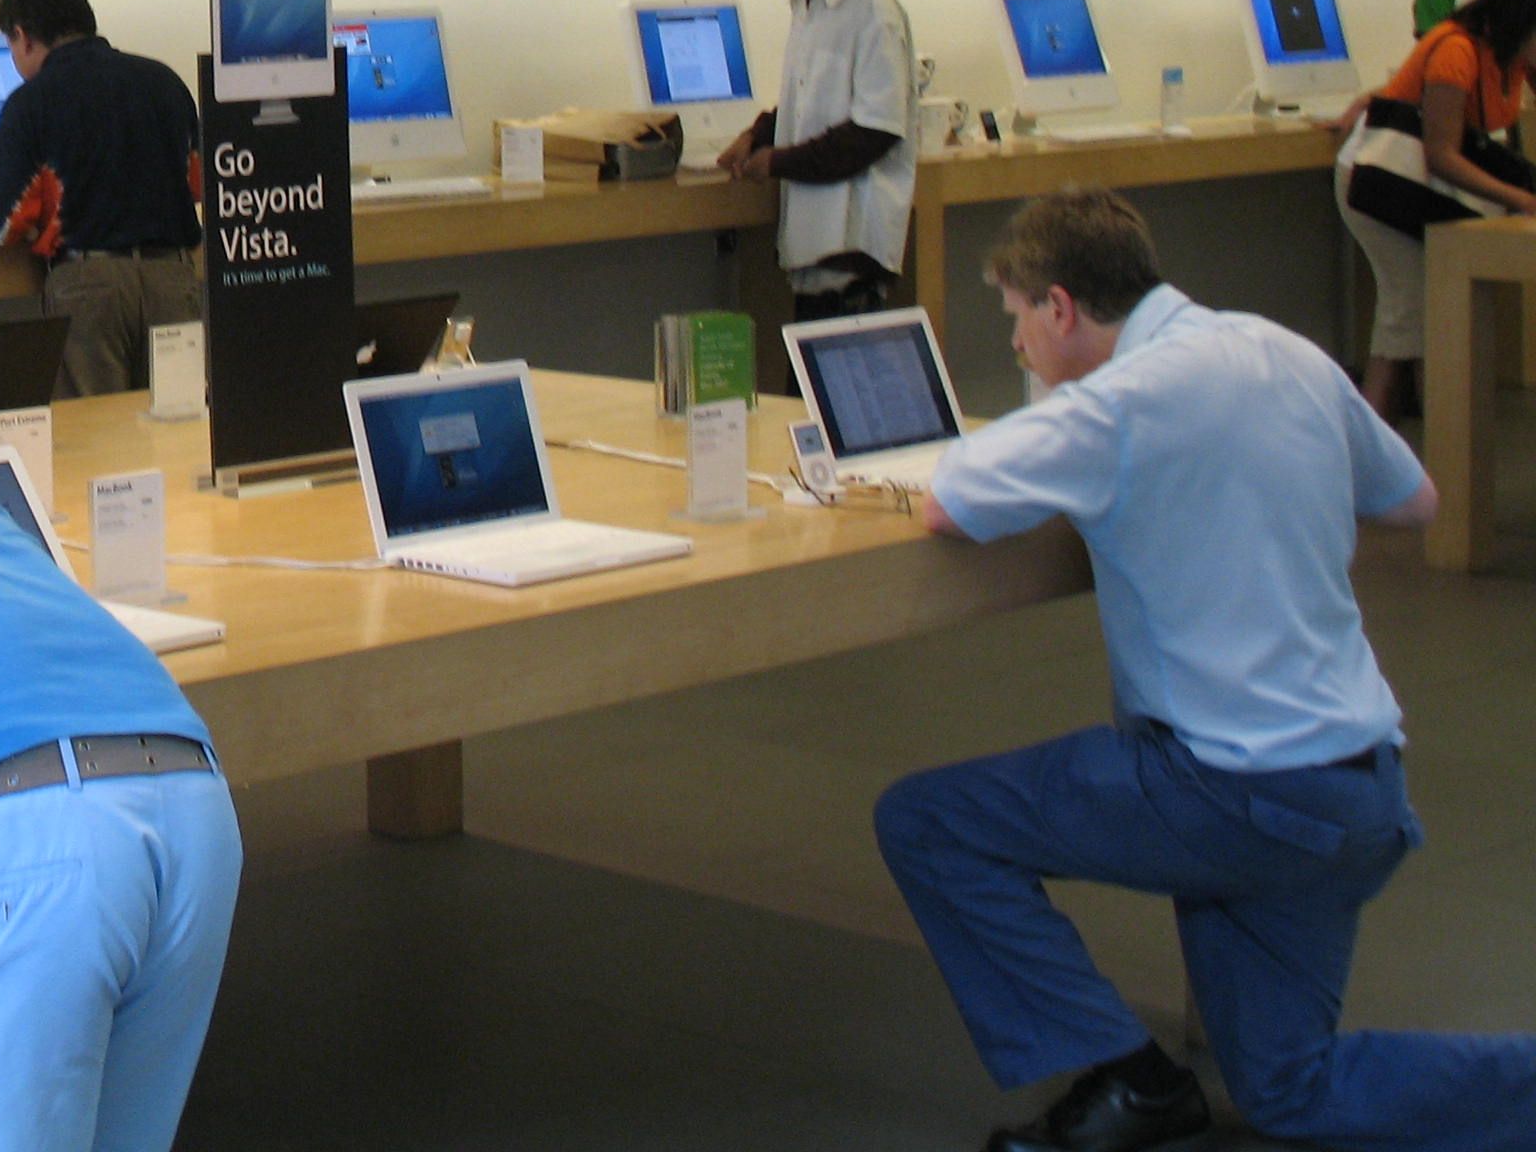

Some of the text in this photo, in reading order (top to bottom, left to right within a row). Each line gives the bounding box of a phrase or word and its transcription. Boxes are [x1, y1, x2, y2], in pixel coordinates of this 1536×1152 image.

[214, 142, 255, 178] Go
[218, 173, 324, 224] beyond
[220, 225, 298, 263] Vista.
[240, 269, 264, 285] time
[266, 266, 278, 282] to
[279, 266, 297, 284] get
[298, 267, 305, 279] a
